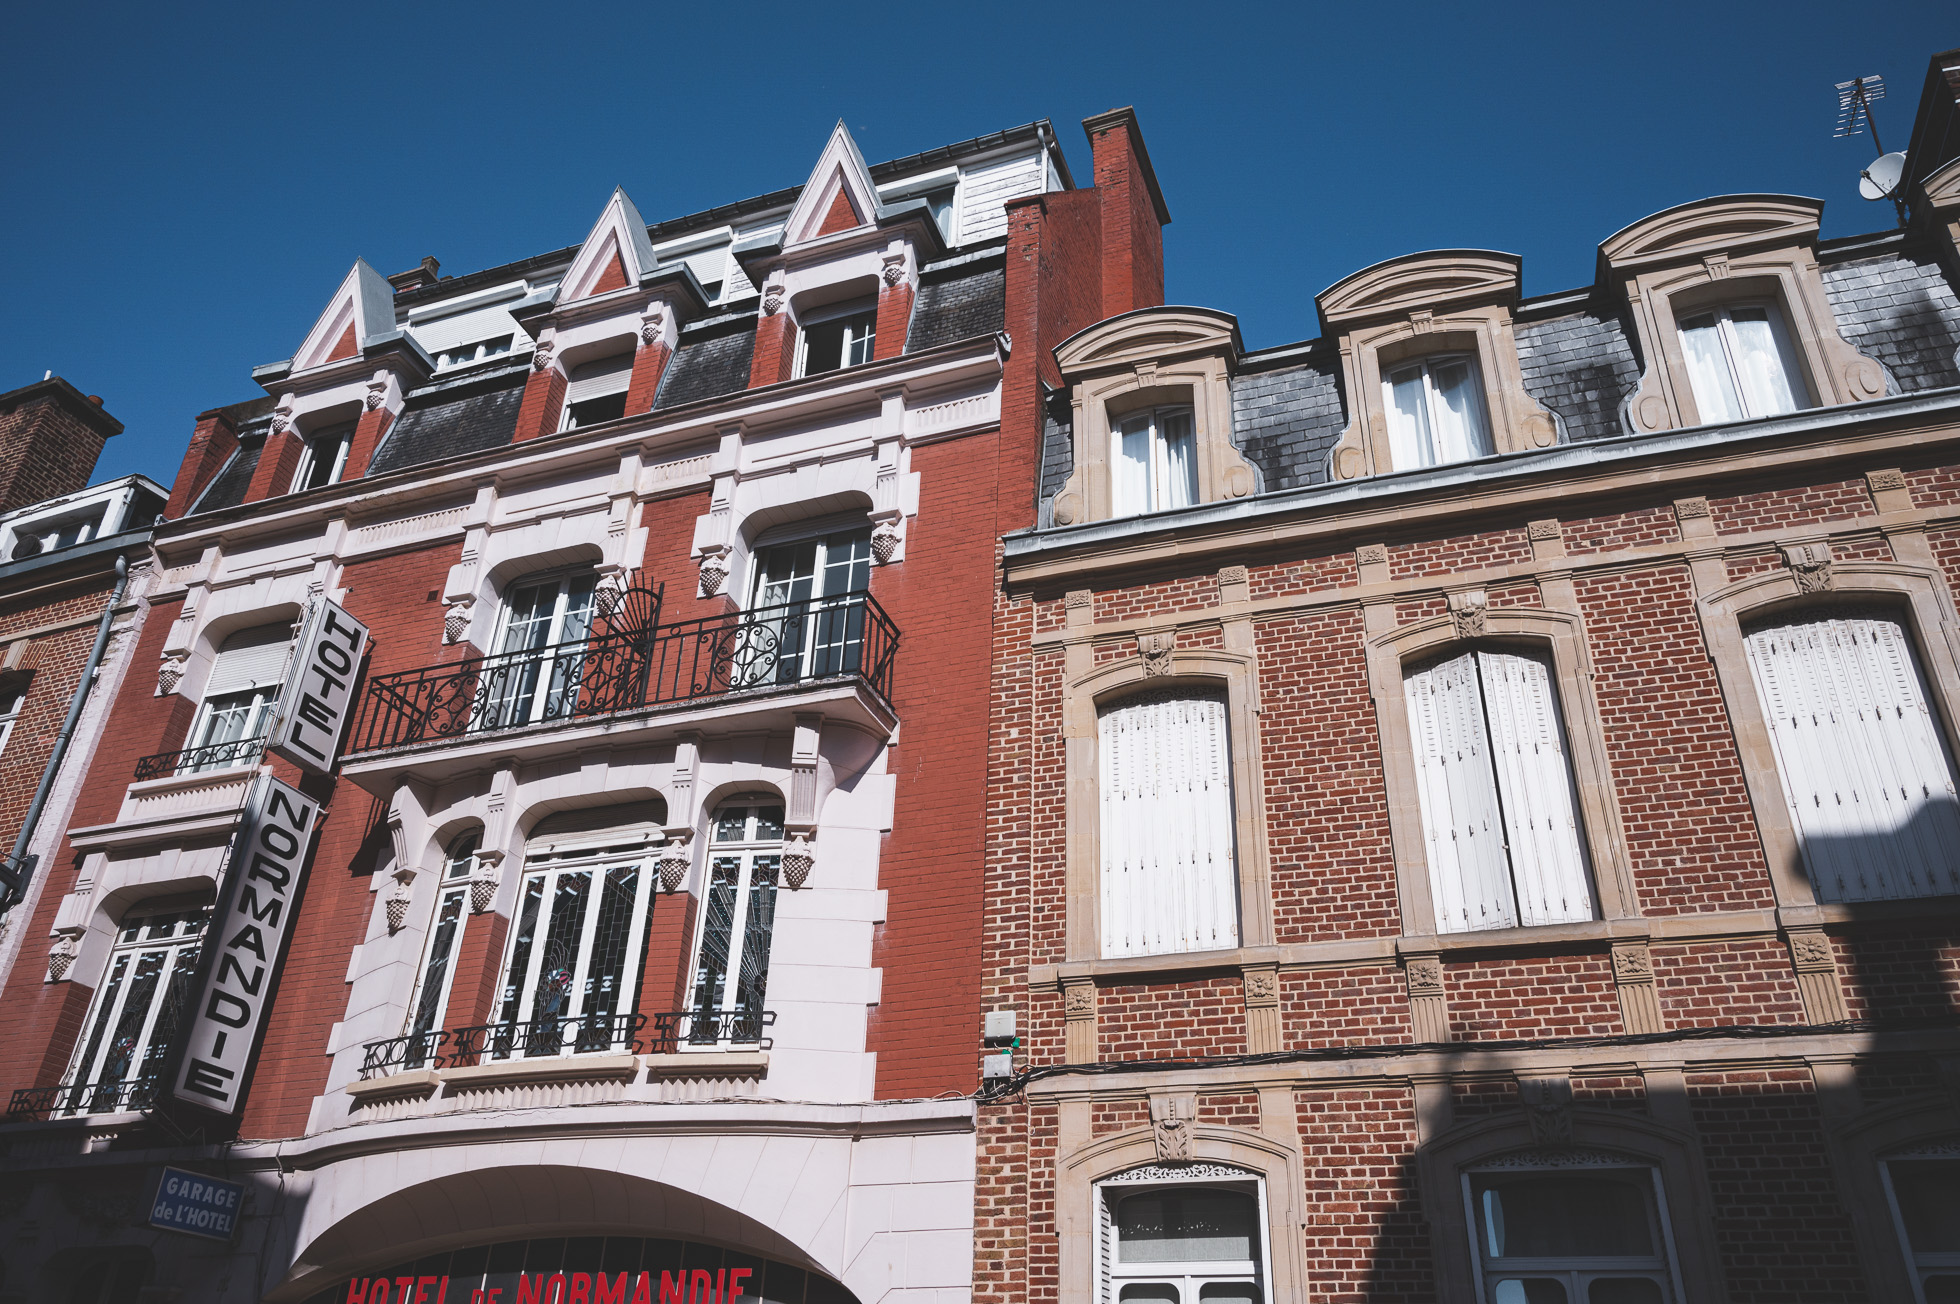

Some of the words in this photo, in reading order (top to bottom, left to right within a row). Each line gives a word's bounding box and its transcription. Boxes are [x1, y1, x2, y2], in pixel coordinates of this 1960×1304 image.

[290, 609, 361, 762] HOTEL
[184, 789, 311, 1102] NORMANDIE
[155, 1202, 173, 1220] de
[176, 1205, 232, 1232] L'HOTEL
[167, 1178, 237, 1208] GARAGE
